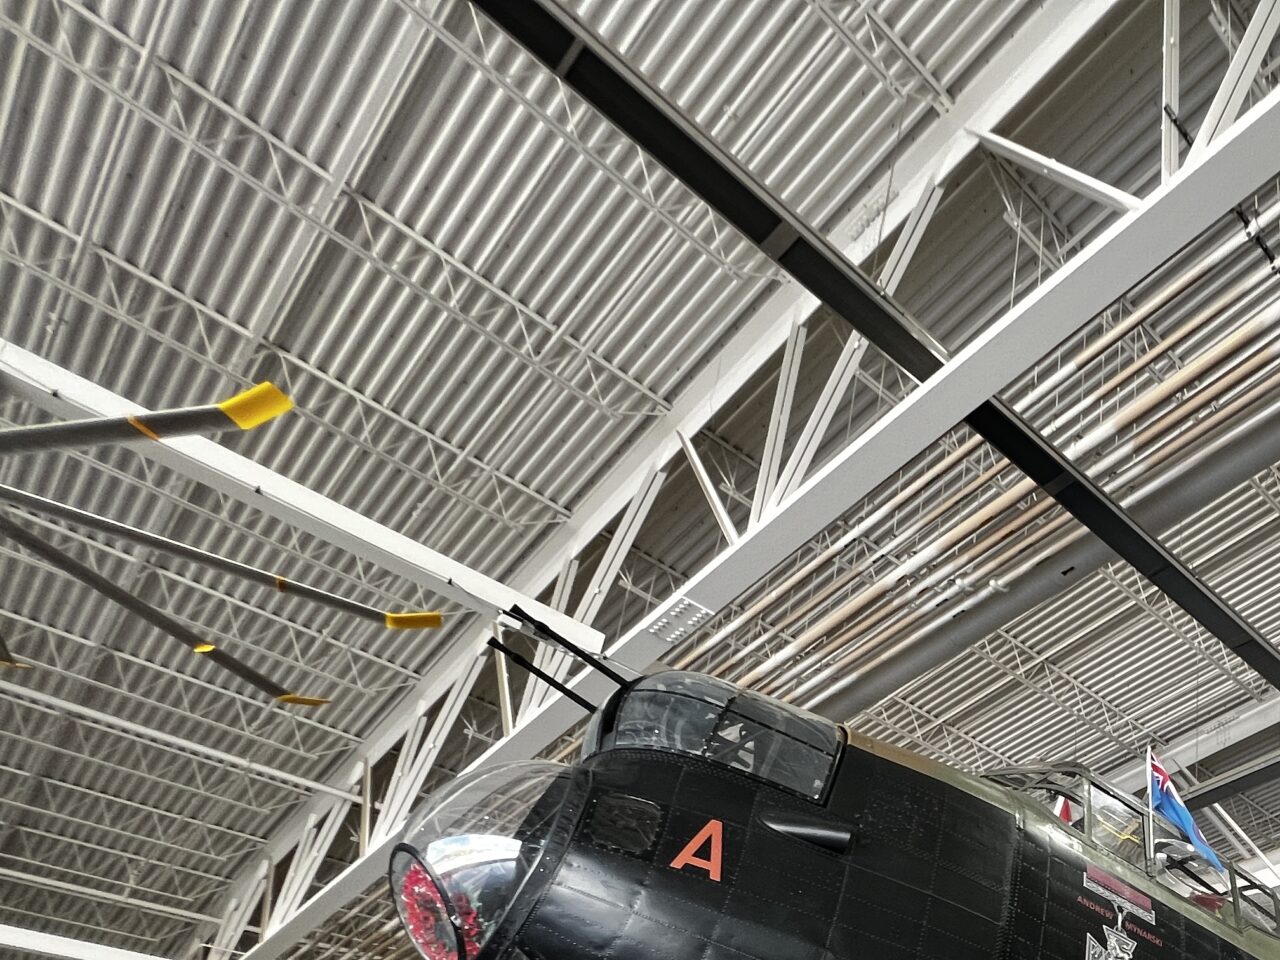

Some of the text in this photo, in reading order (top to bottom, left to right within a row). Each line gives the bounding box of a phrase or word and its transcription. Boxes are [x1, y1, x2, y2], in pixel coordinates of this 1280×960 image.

[669, 818, 723, 882] A
[1077, 895, 1114, 919] ANDREW
[1125, 921, 1162, 947] MYNARSKI
